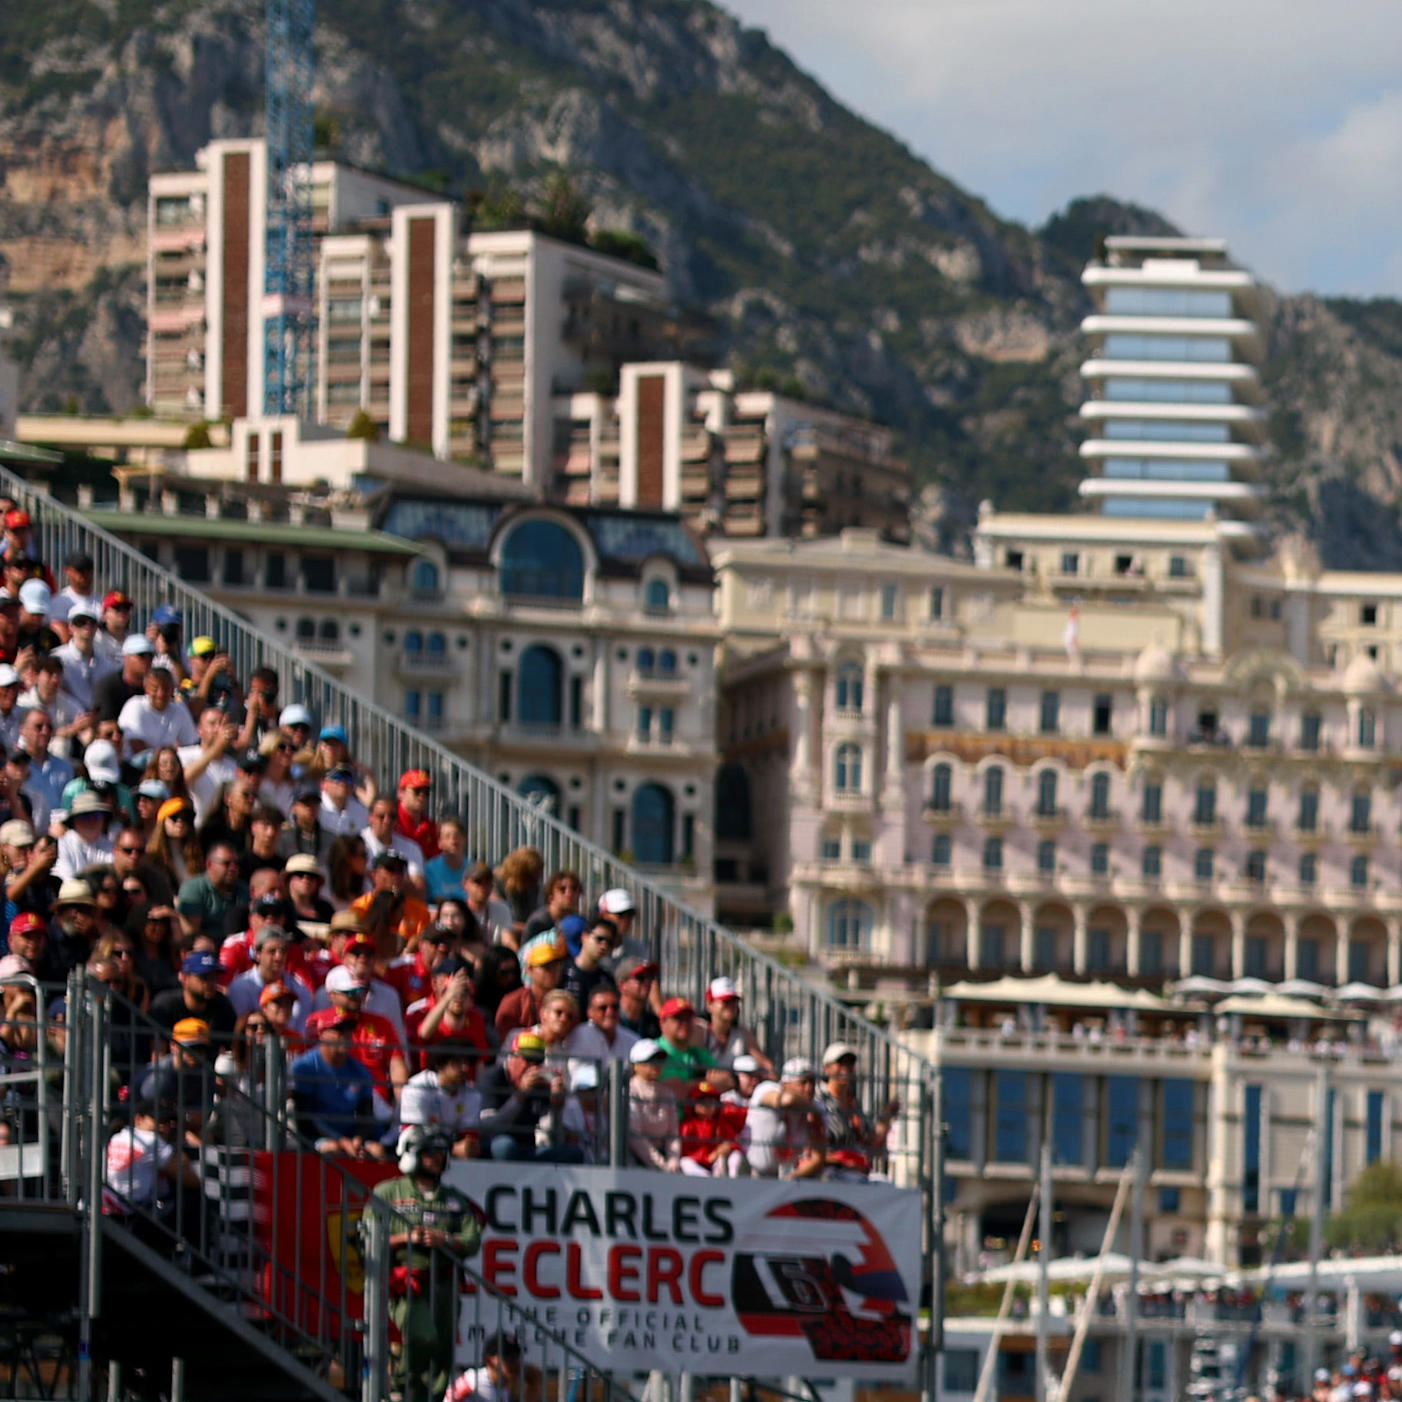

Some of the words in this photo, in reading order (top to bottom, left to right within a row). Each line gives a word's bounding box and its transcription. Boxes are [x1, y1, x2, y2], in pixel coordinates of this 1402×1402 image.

[484, 1184, 735, 1243] CHARLES
[458, 1238, 727, 1307] ECLERC
[576, 1307, 705, 1333] OFFICIAL
[607, 1328, 658, 1352] FAN
[672, 1334, 742, 1354] CLUB
